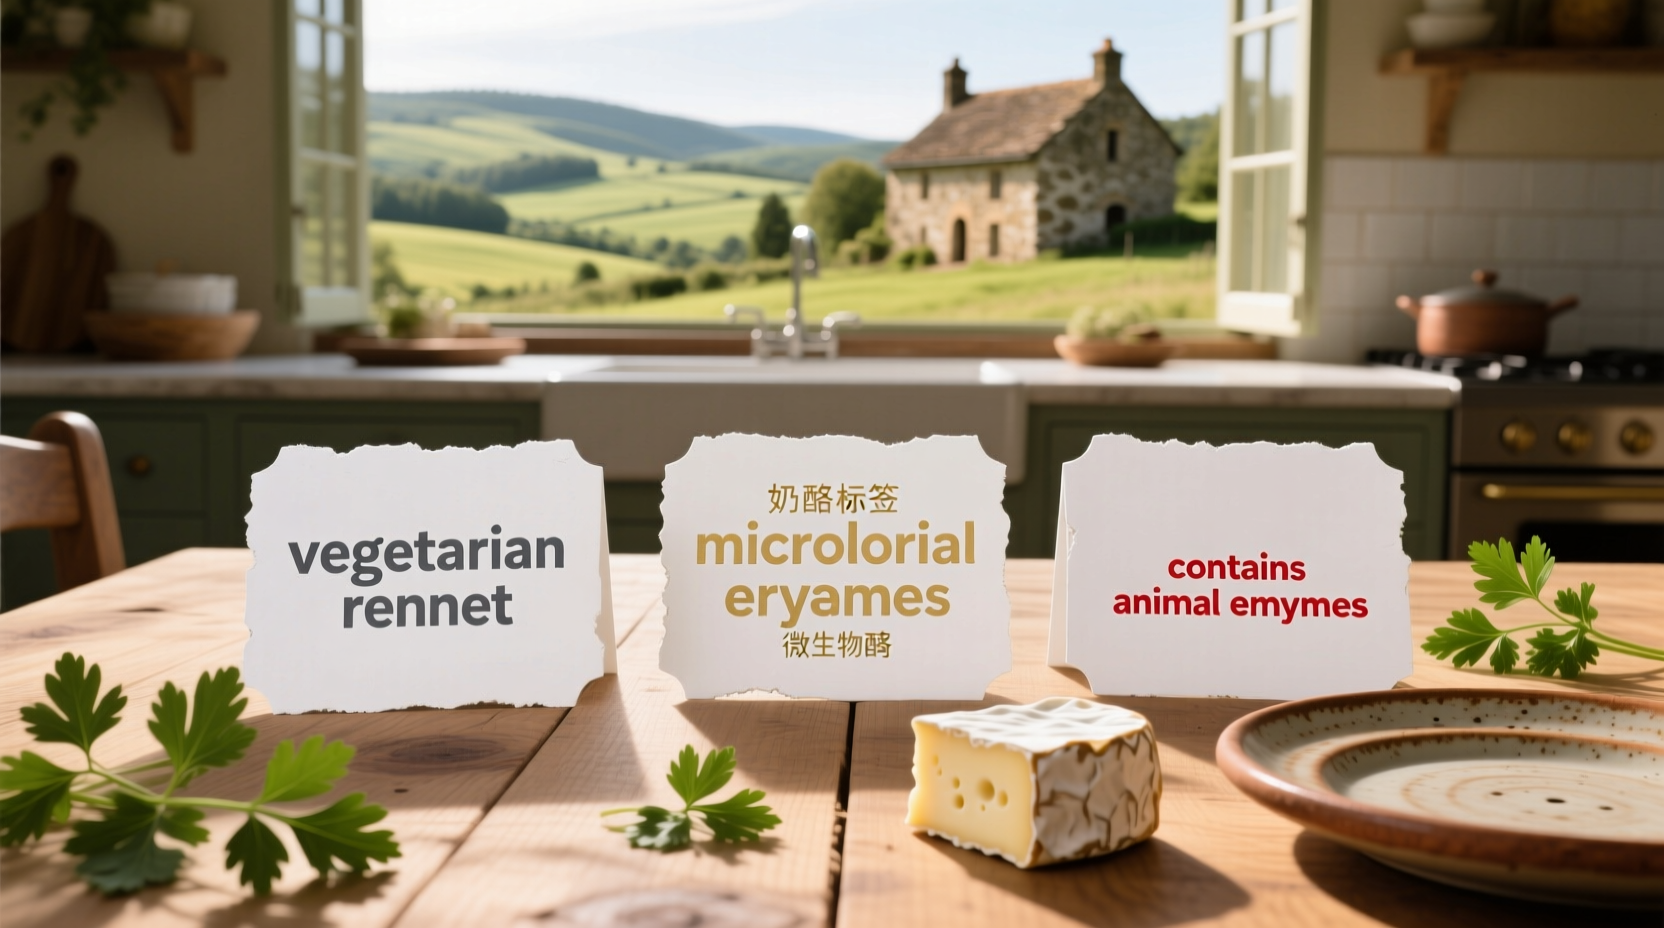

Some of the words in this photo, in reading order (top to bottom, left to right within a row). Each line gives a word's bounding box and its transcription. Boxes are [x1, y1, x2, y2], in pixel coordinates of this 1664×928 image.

[768, 483, 899, 514] 奶酪标签
[288, 525, 565, 587] vegetarian
[696, 520, 975, 565] microlorial
[1168, 552, 1306, 581] contains
[342, 585, 514, 629] rennet
[725, 584, 951, 628] eryames
[1113, 586, 1221, 616] animal
[1230, 595, 1369, 625] emymes
